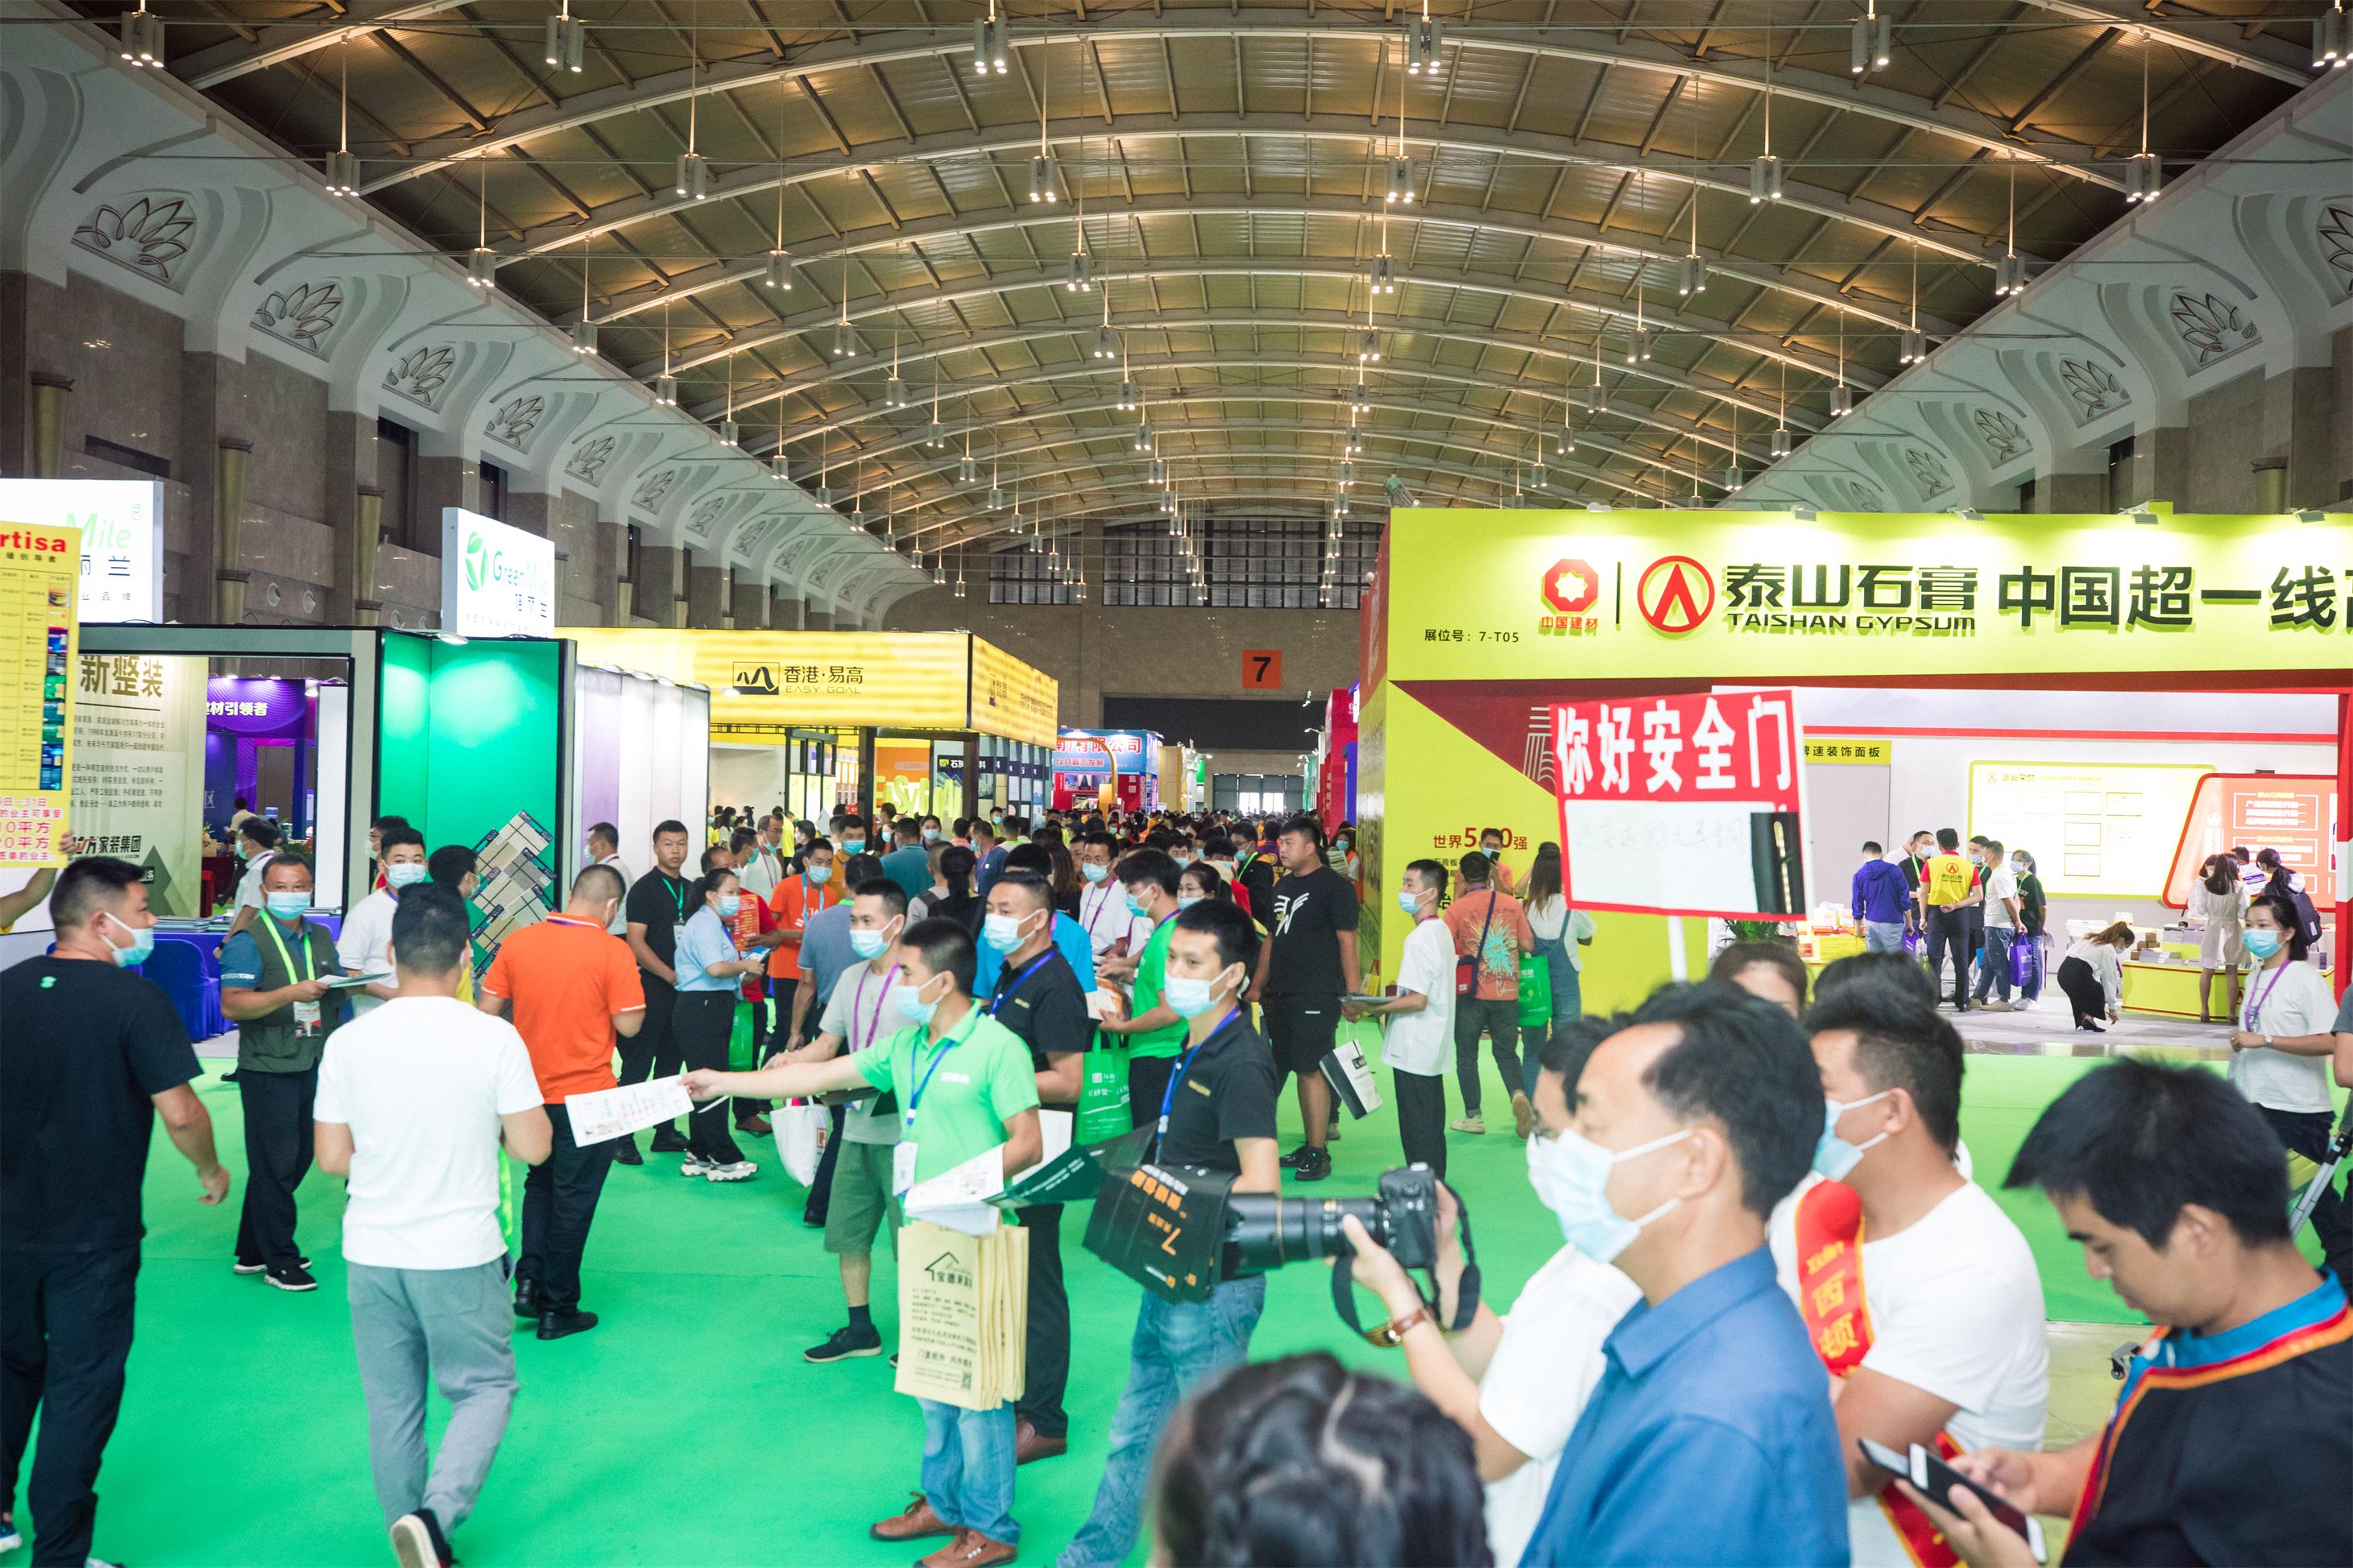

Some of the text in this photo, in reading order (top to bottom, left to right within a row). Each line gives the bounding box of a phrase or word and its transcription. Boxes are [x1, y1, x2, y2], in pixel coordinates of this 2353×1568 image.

[1726, 563, 1978, 610] 泰山石膏
[1541, 616, 1598, 629] 中国建材
[1727, 613, 1975, 630] TAISHAN GYPSUM
[1479, 631, 1519, 643] 7-T05
[1253, 656, 1271, 682] 7
[1556, 695, 1791, 795] 你好安全门
[1434, 827, 1527, 850] 世界50强
